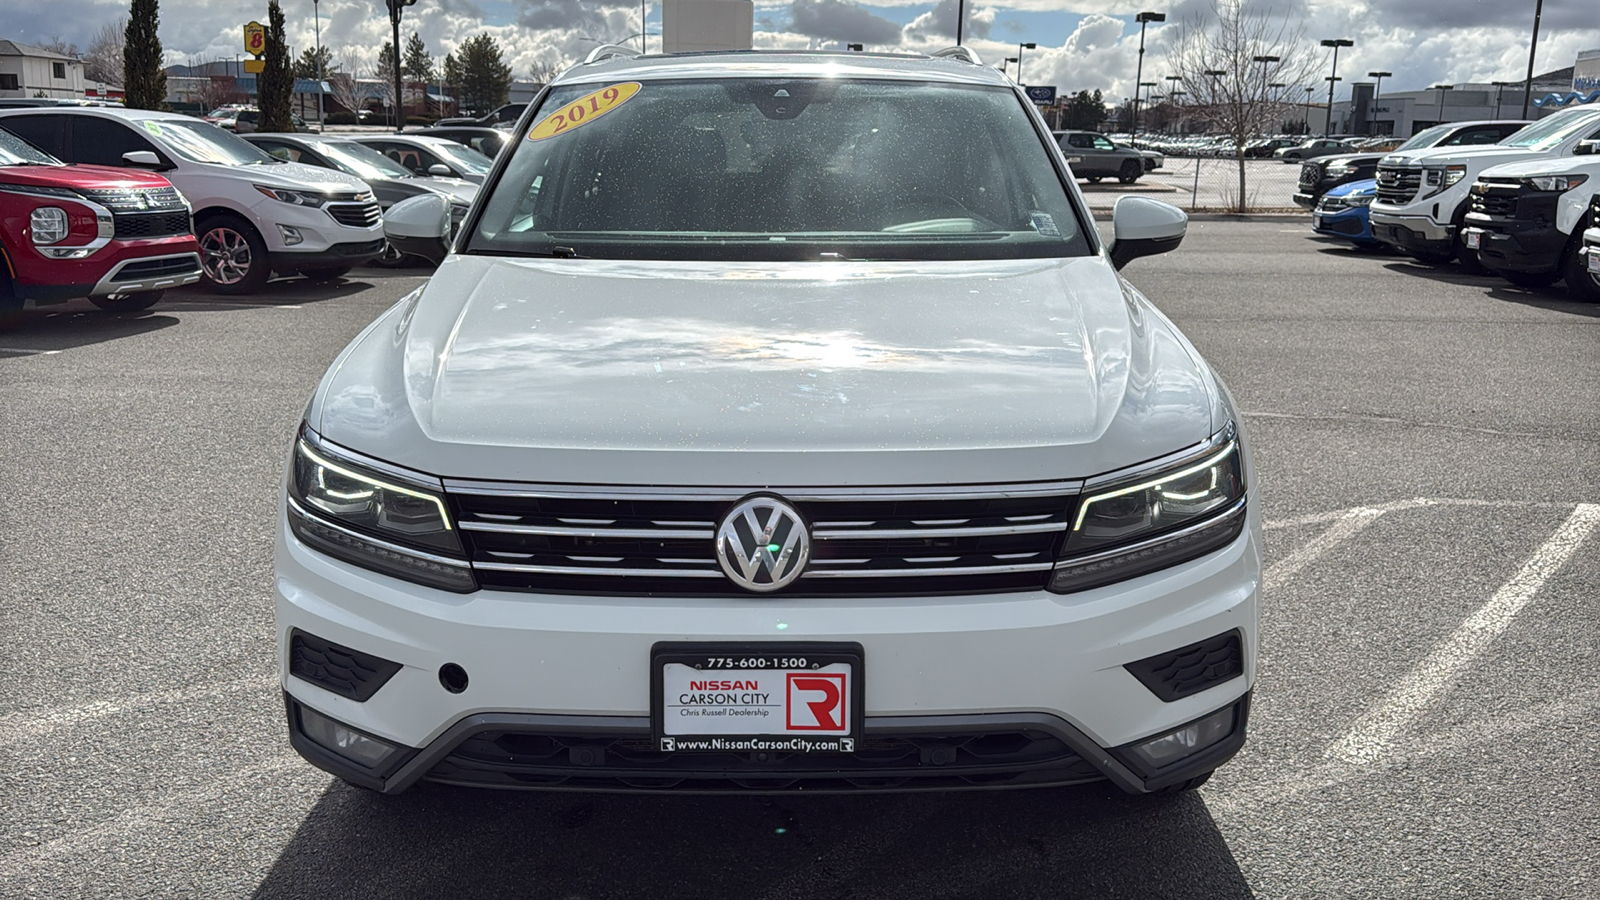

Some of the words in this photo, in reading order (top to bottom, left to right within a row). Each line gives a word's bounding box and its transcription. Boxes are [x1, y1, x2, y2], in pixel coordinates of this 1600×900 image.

[250, 32, 262, 48] 8
[550, 88, 619, 133] 2019
[707, 658, 807, 668] 775-600-1500
[690, 680, 758, 691] NISSAN
[679, 693, 737, 705] CARSON
[741, 693, 770, 705] CITY
[680, 708, 700, 717] Chris
[701, 708, 727, 717] Russell
[728, 708, 770, 718] Dealership
[676, 738, 838, 753] www.NissanCarsonCity.com
